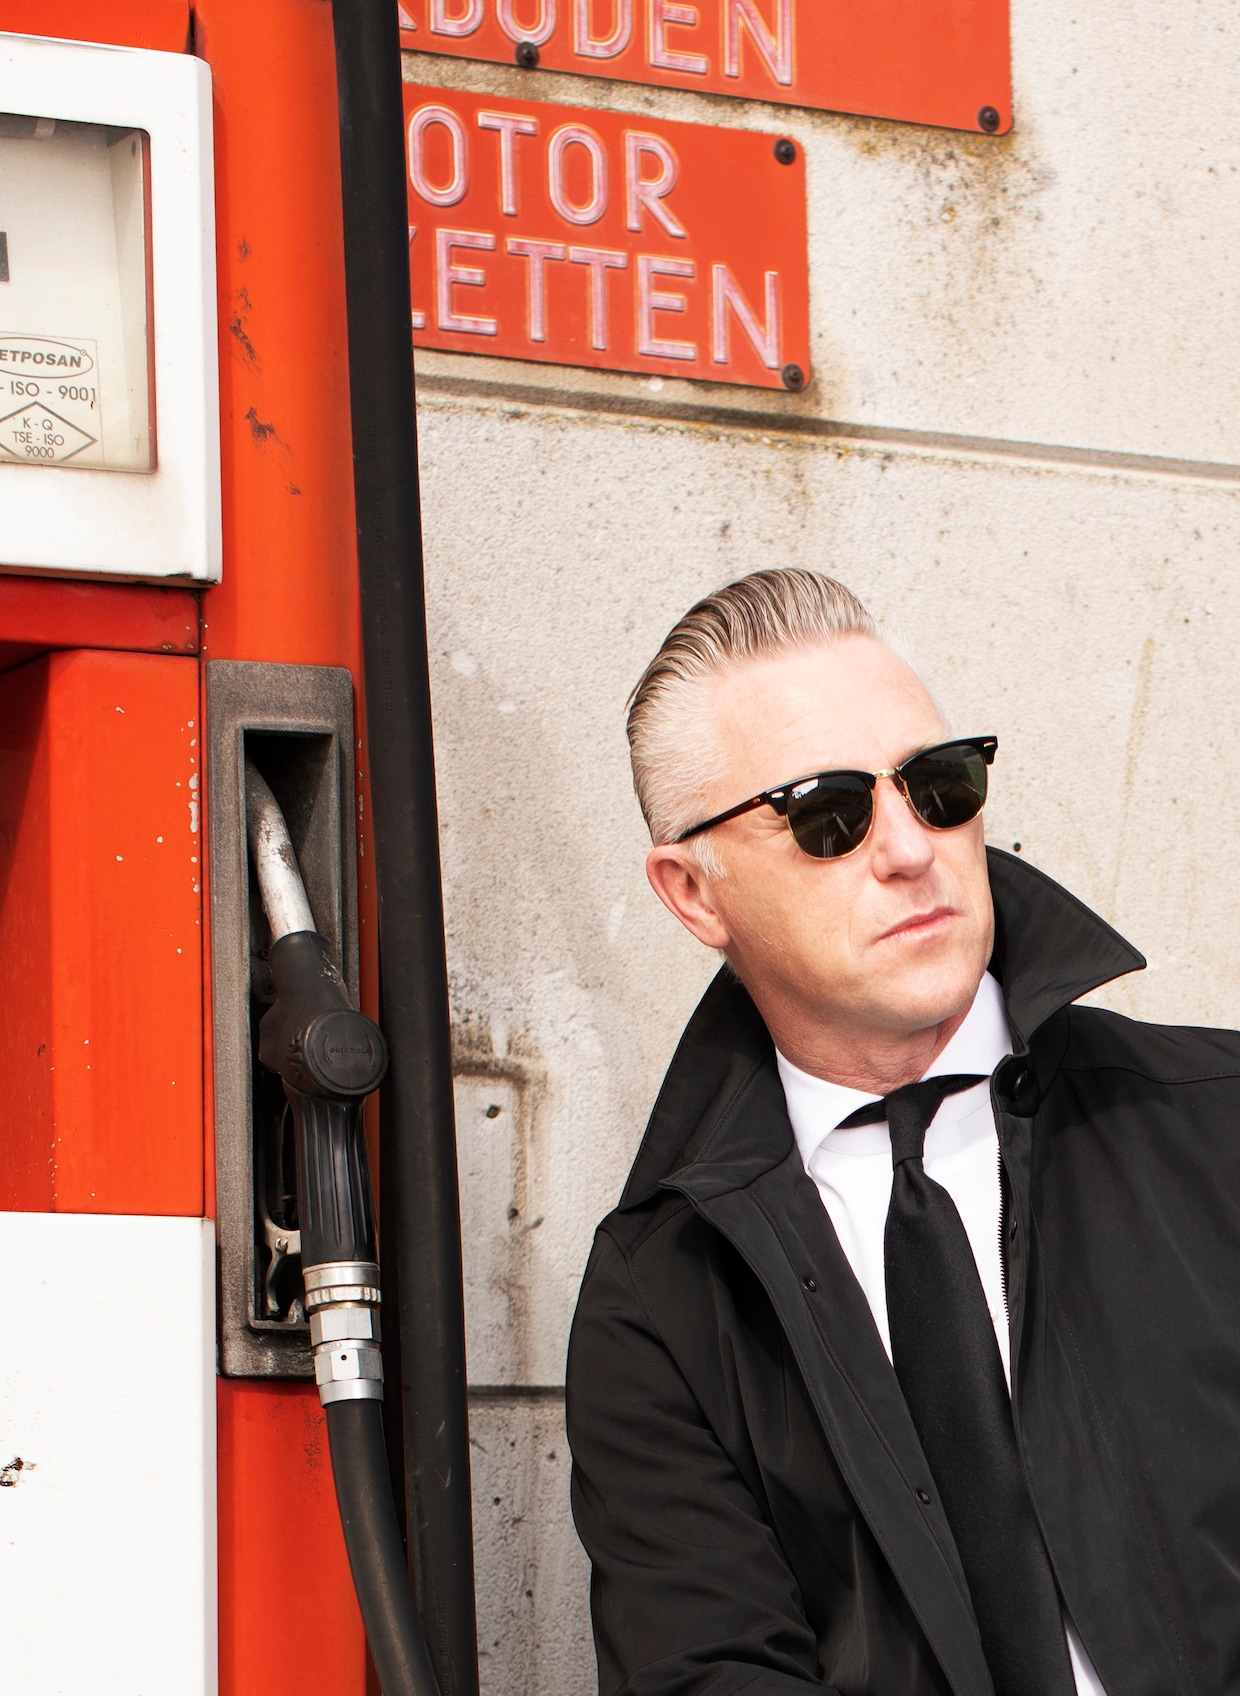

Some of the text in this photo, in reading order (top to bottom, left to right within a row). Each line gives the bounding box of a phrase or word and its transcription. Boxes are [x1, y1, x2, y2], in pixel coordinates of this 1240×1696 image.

[398, 0, 793, 86] DEN
[408, 225, 780, 371] ETTEN
[11, 380, 40, 397] ISO
[58, 385, 96, 402] 9001
[12, 431, 33, 444] TSE
[43, 433, 65, 447] ISO
[25, 445, 55, 459] 9000
